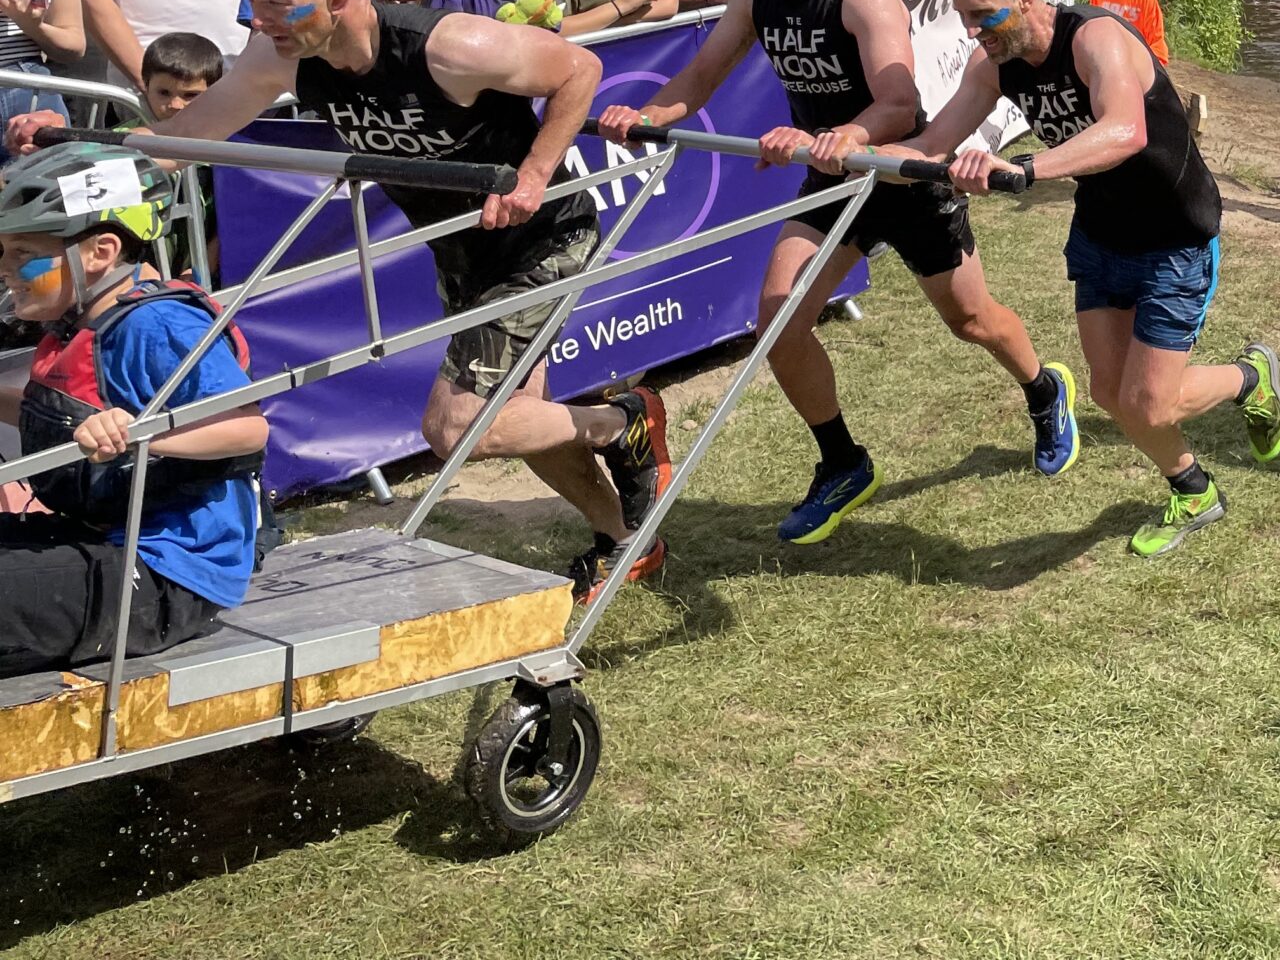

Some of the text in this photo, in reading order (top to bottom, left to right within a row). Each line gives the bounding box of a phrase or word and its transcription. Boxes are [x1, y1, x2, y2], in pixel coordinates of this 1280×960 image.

[763, 26, 826, 54] HALF
[772, 54, 844, 79] MOON
[1037, 83, 1057, 93] THE
[328, 103, 425, 130] HALF
[1018, 88, 1079, 119] HALF
[334, 127, 456, 153] MOON
[584, 297, 683, 351] Wealth
